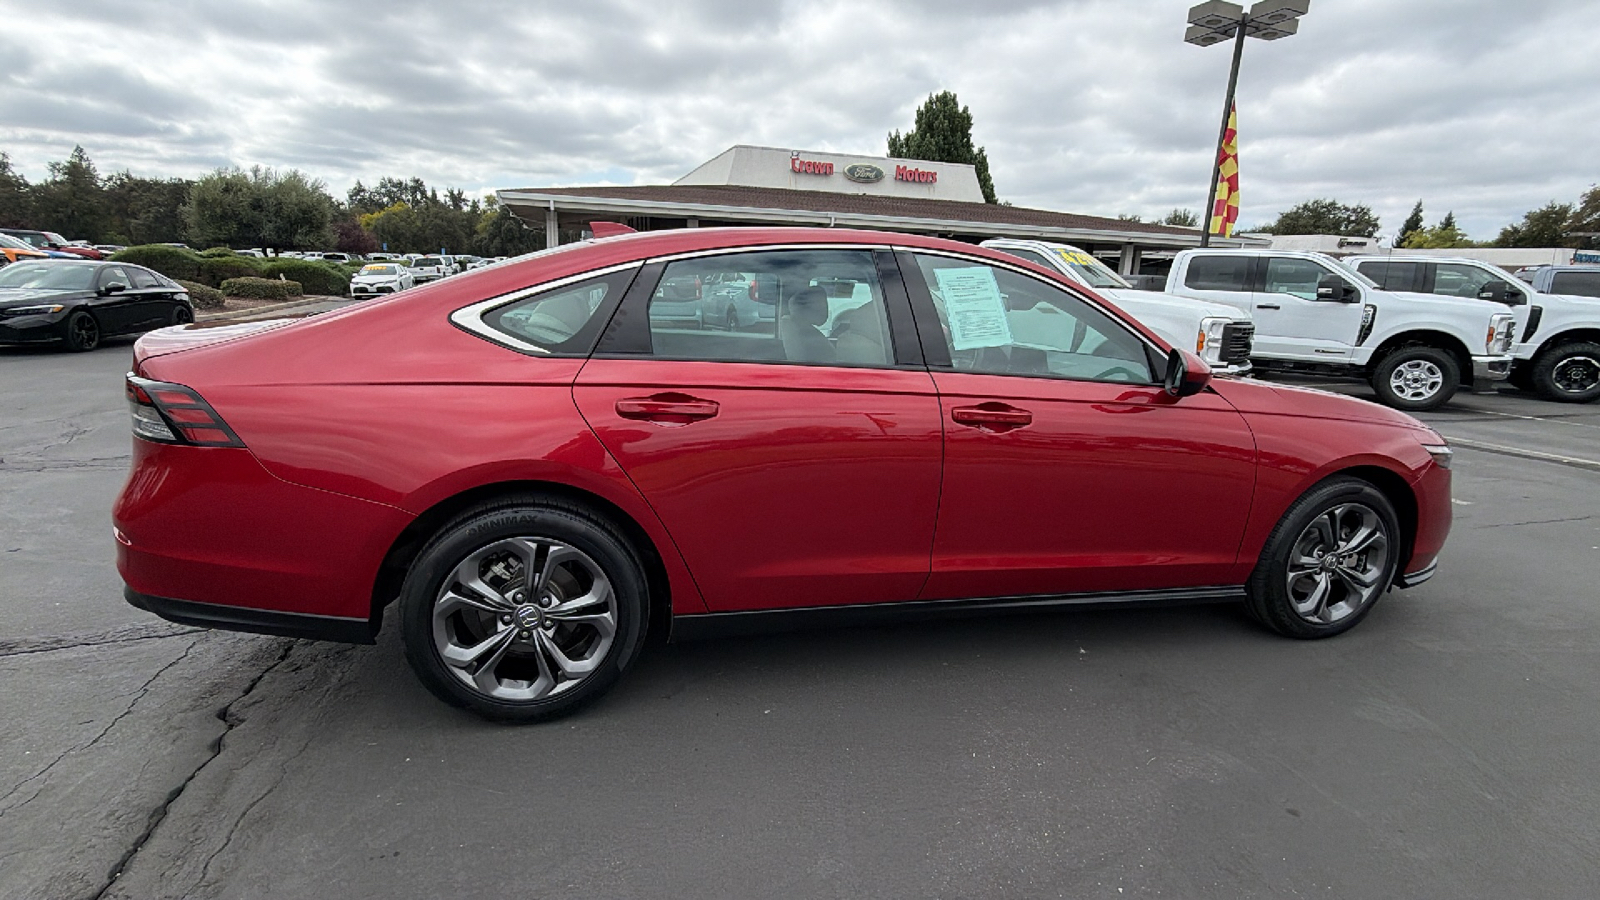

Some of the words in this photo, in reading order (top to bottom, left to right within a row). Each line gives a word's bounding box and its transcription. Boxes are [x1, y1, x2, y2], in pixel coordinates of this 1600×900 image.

[791, 157, 834, 175] Crown
[895, 165, 938, 184] Motors
[854, 165, 878, 180] Ford
